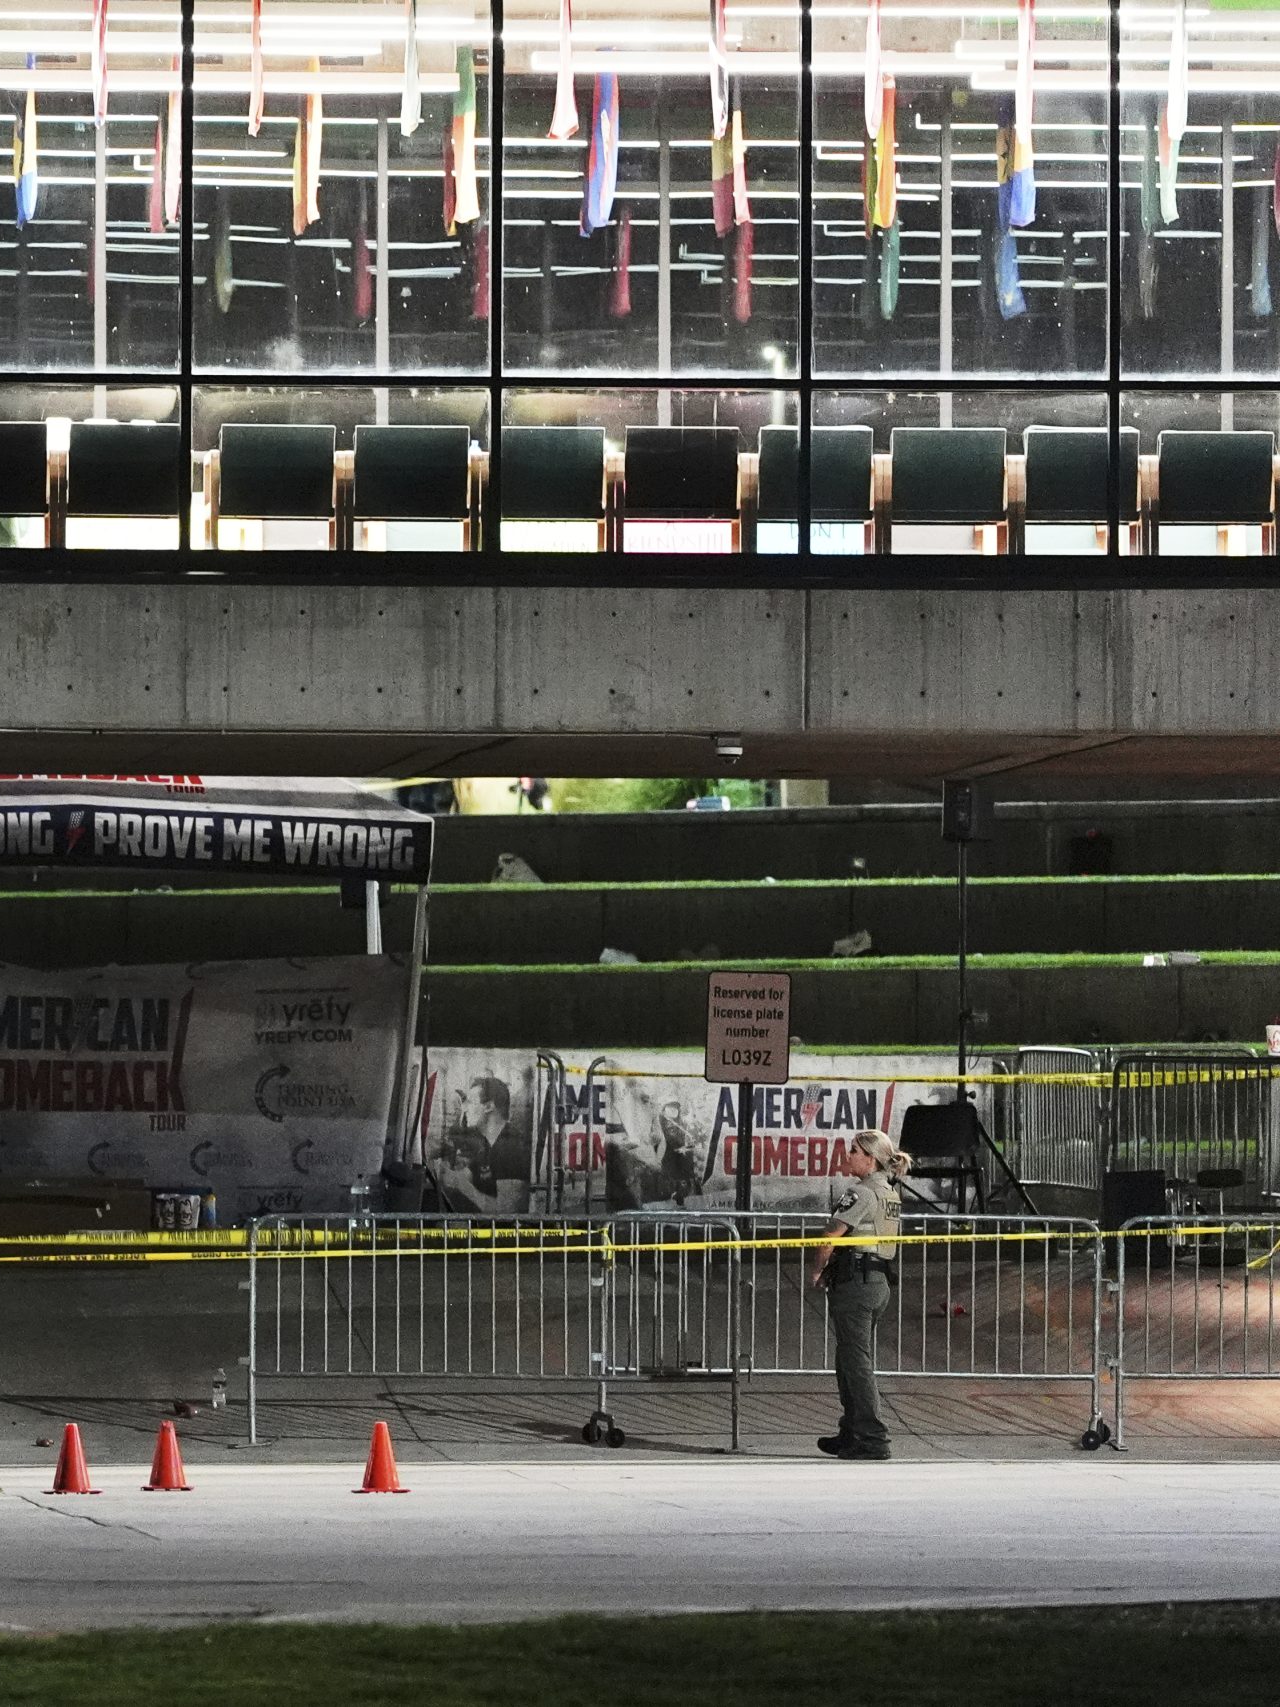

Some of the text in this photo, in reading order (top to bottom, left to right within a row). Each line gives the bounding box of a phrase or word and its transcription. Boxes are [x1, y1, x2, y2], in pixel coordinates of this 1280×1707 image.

[94, 811, 414, 870] PROVE ME WRONG
[713, 986, 784, 1000] Reserved for
[713, 1006, 784, 1021] license plate
[255, 1029, 353, 1044] YREFY.COM
[726, 1025, 770, 1038] number
[149, 1114, 187, 1131] TOUR
[723, 1135, 854, 1178] COMEBA
